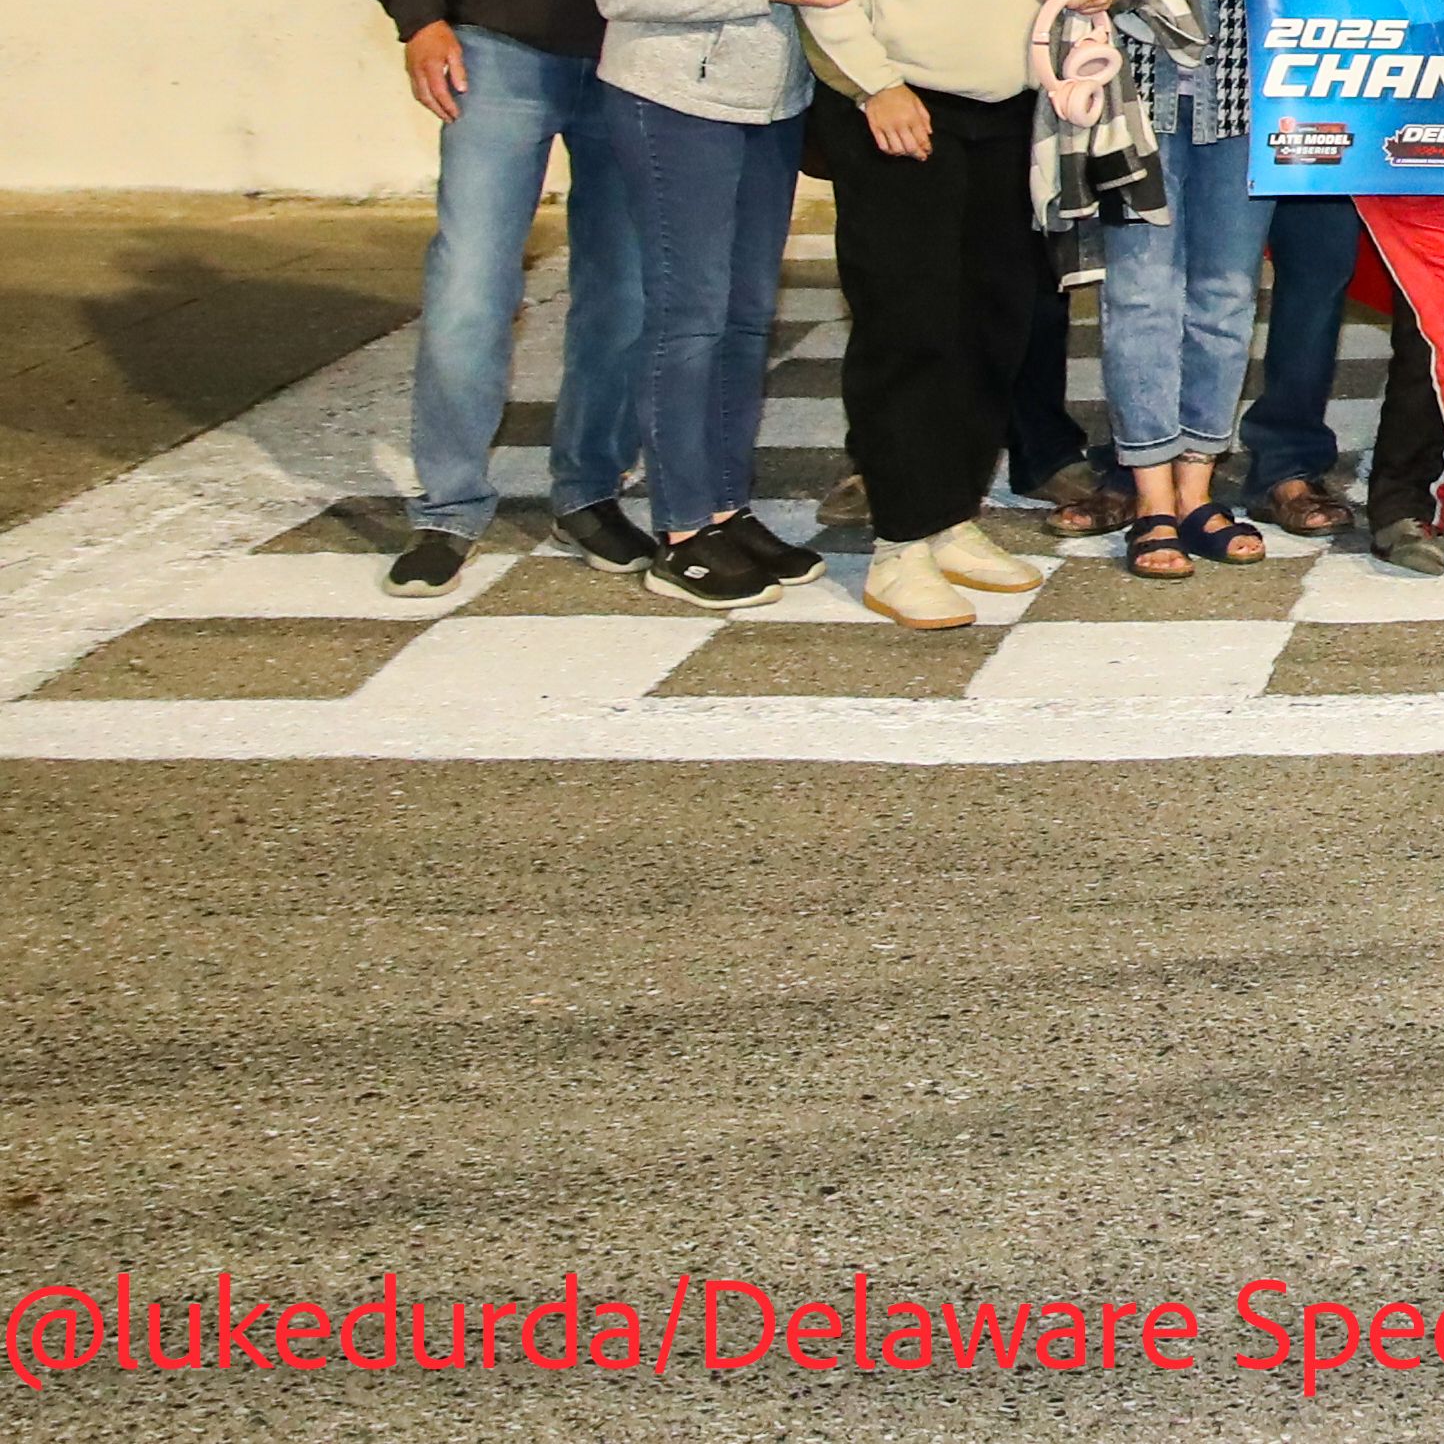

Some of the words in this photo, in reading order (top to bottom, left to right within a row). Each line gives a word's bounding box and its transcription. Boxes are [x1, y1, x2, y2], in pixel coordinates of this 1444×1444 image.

[1263, 18, 1409, 49] 2025
[1270, 134, 1303, 145] LATE
[1305, 134, 1351, 145] MODEL
